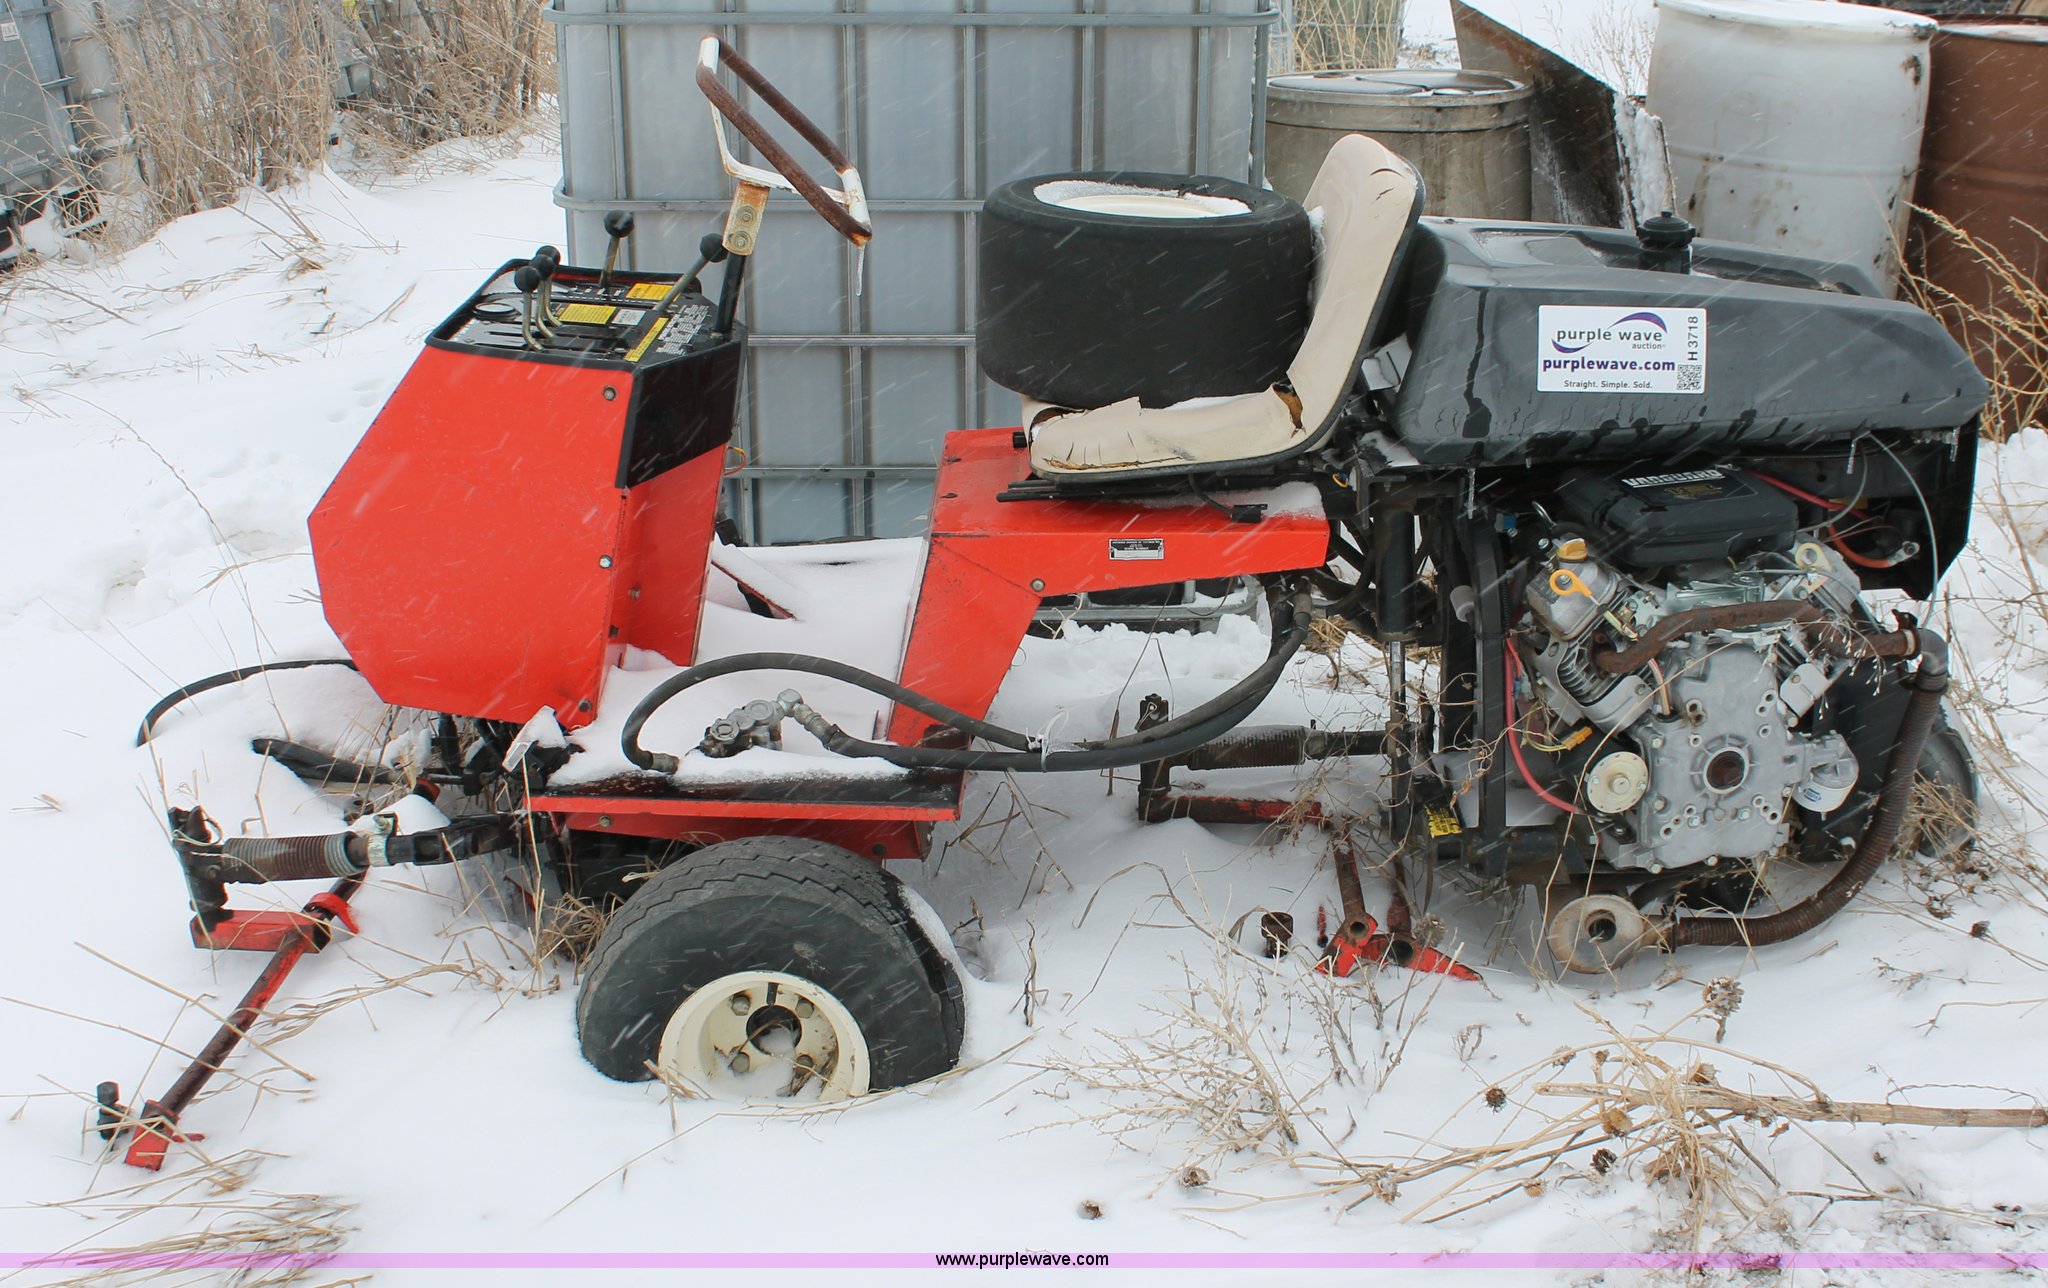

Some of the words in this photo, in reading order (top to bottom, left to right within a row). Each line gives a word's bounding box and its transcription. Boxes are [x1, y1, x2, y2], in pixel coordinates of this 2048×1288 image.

[1557, 328, 1612, 342] purple
[1618, 332, 1662, 341] wave
[1543, 356, 1675, 372] purplewave.com
[1564, 380, 1598, 389] Straight.
[1600, 380, 1631, 389] Simple.
[1633, 381, 1653, 389] Sold.
[1621, 469, 1723, 487] VANGUARD
